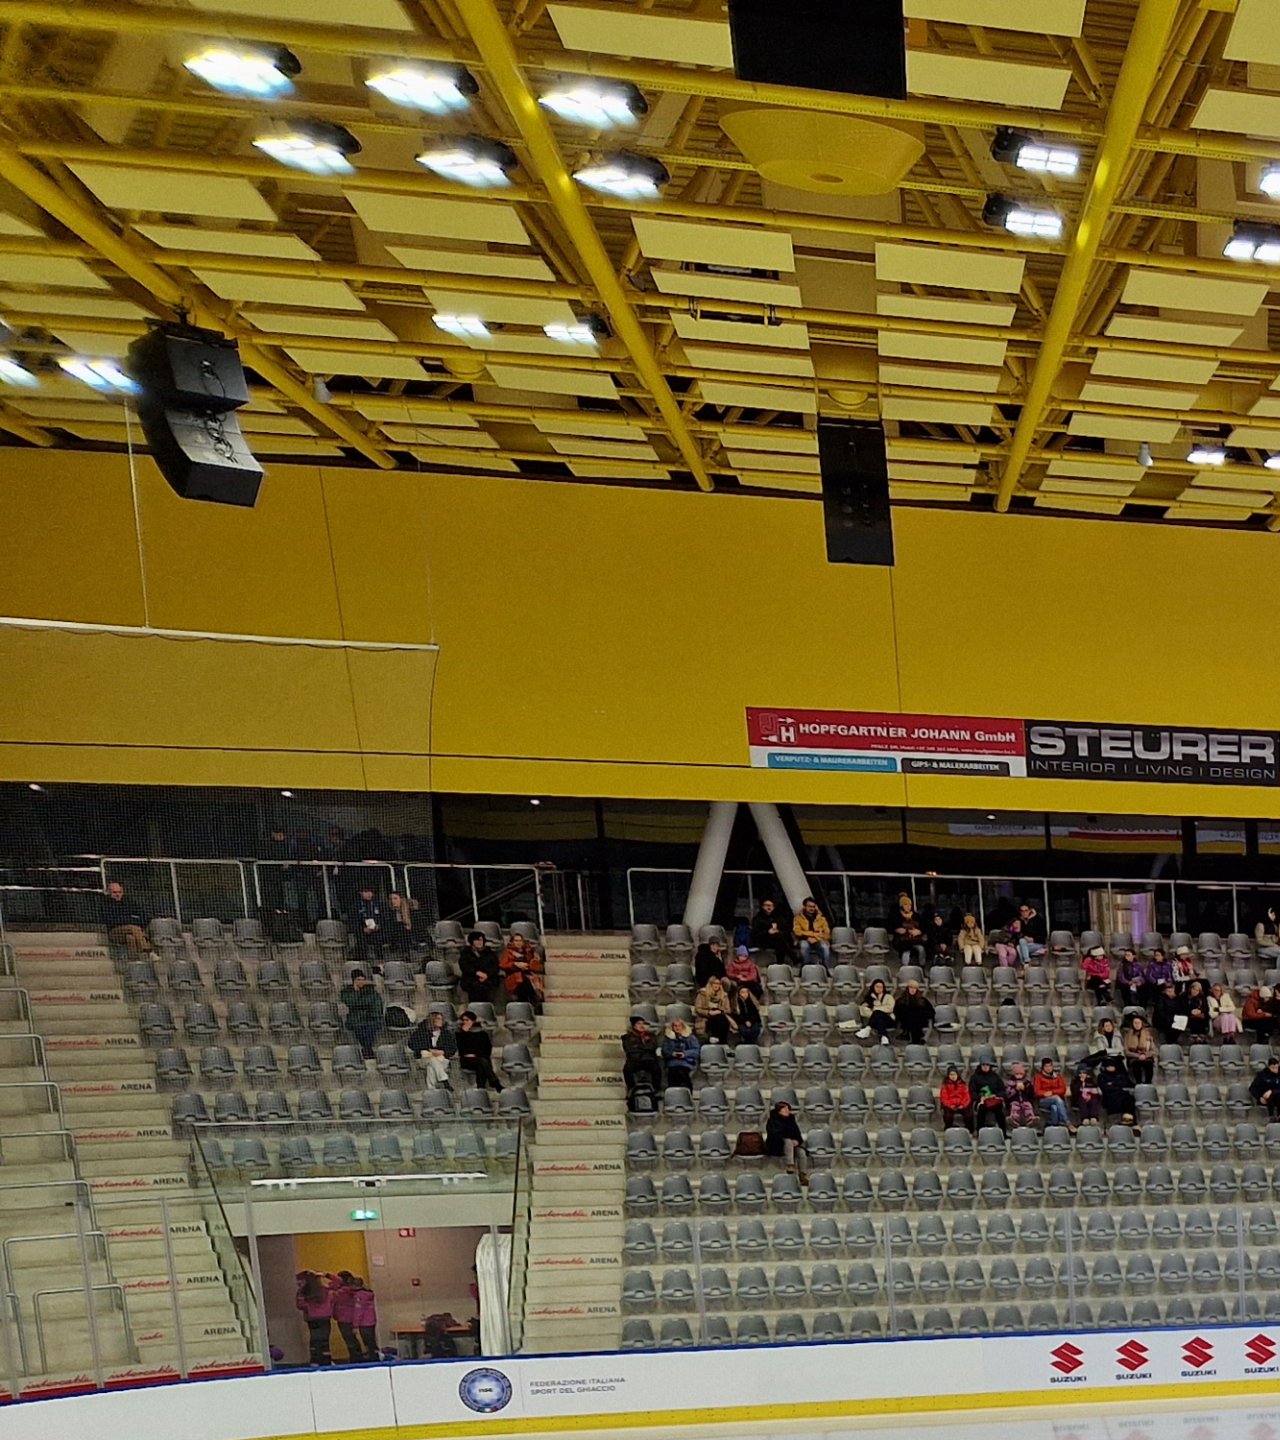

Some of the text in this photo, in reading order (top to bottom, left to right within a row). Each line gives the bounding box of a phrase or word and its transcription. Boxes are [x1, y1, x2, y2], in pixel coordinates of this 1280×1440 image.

[799, 723, 1015, 743] HOPFGARTNER JOHANN GmbH
[1030, 726, 1275, 764] STEURER
[1031, 760, 1276, 780] INTERIOR LIVING DESIGN
[1181, 1369, 1217, 1377] SUZUKI
[1244, 1366, 1280, 1374] SUZUKI
[530, 1379, 587, 1387] FEDERAZIONE
[577, 1385, 616, 1393] GHIACCIO
